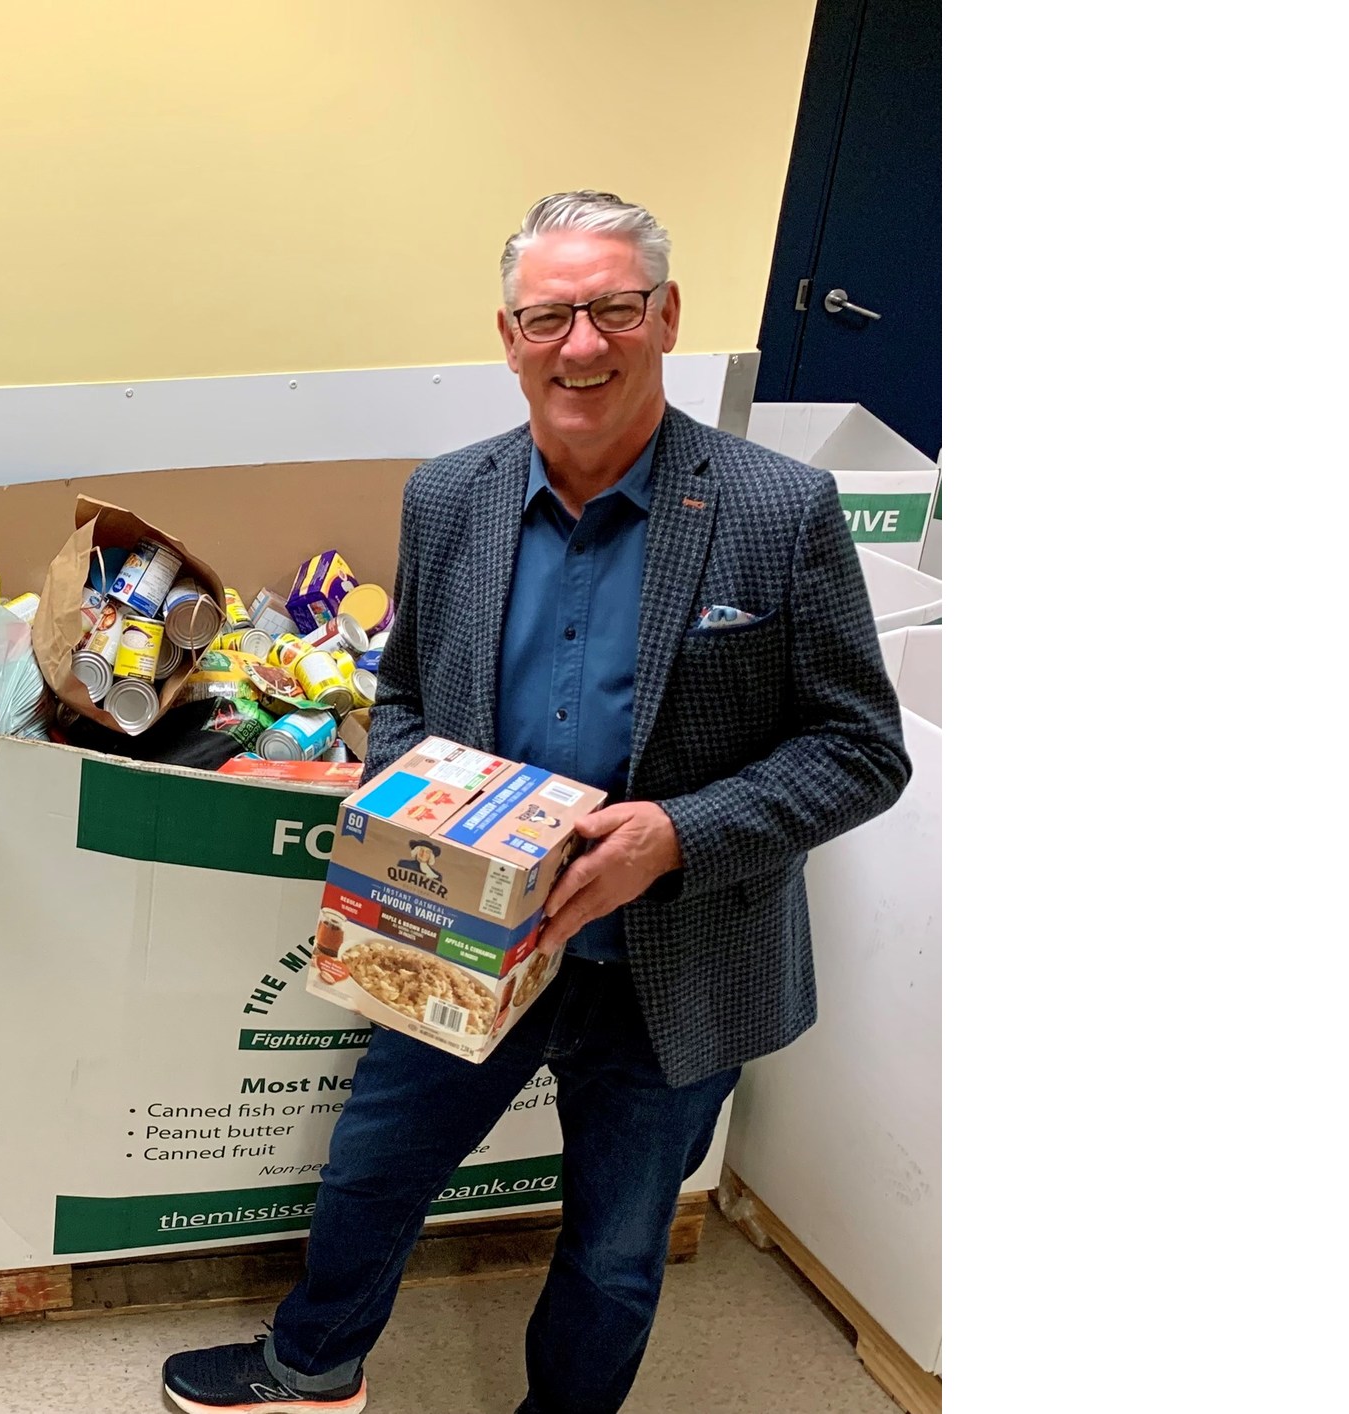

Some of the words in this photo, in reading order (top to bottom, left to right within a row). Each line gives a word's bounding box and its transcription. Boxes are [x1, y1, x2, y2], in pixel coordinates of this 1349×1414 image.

[844, 510, 900, 533] IVE
[347, 812, 364, 829] 60
[387, 866, 448, 899] QUAKER
[370, 889, 412, 914] FLAVOUR
[414, 906, 455, 928] VARIETY
[383, 886, 411, 902] INSTANT
[413, 897, 445, 915] OATMEAL
[243, 973, 287, 1015] THE
[279, 935, 316, 974] MI
[251, 1032, 334, 1048] Fighting
[240, 1077, 311, 1094] Most
[147, 1102, 232, 1118] Canned
[238, 1102, 275, 1117] fish
[282, 1104, 304, 1116] or
[146, 1125, 221, 1140] Peanut
[227, 1124, 295, 1139] butter
[143, 1145, 226, 1161] Canned
[232, 1144, 277, 1158] fruit
